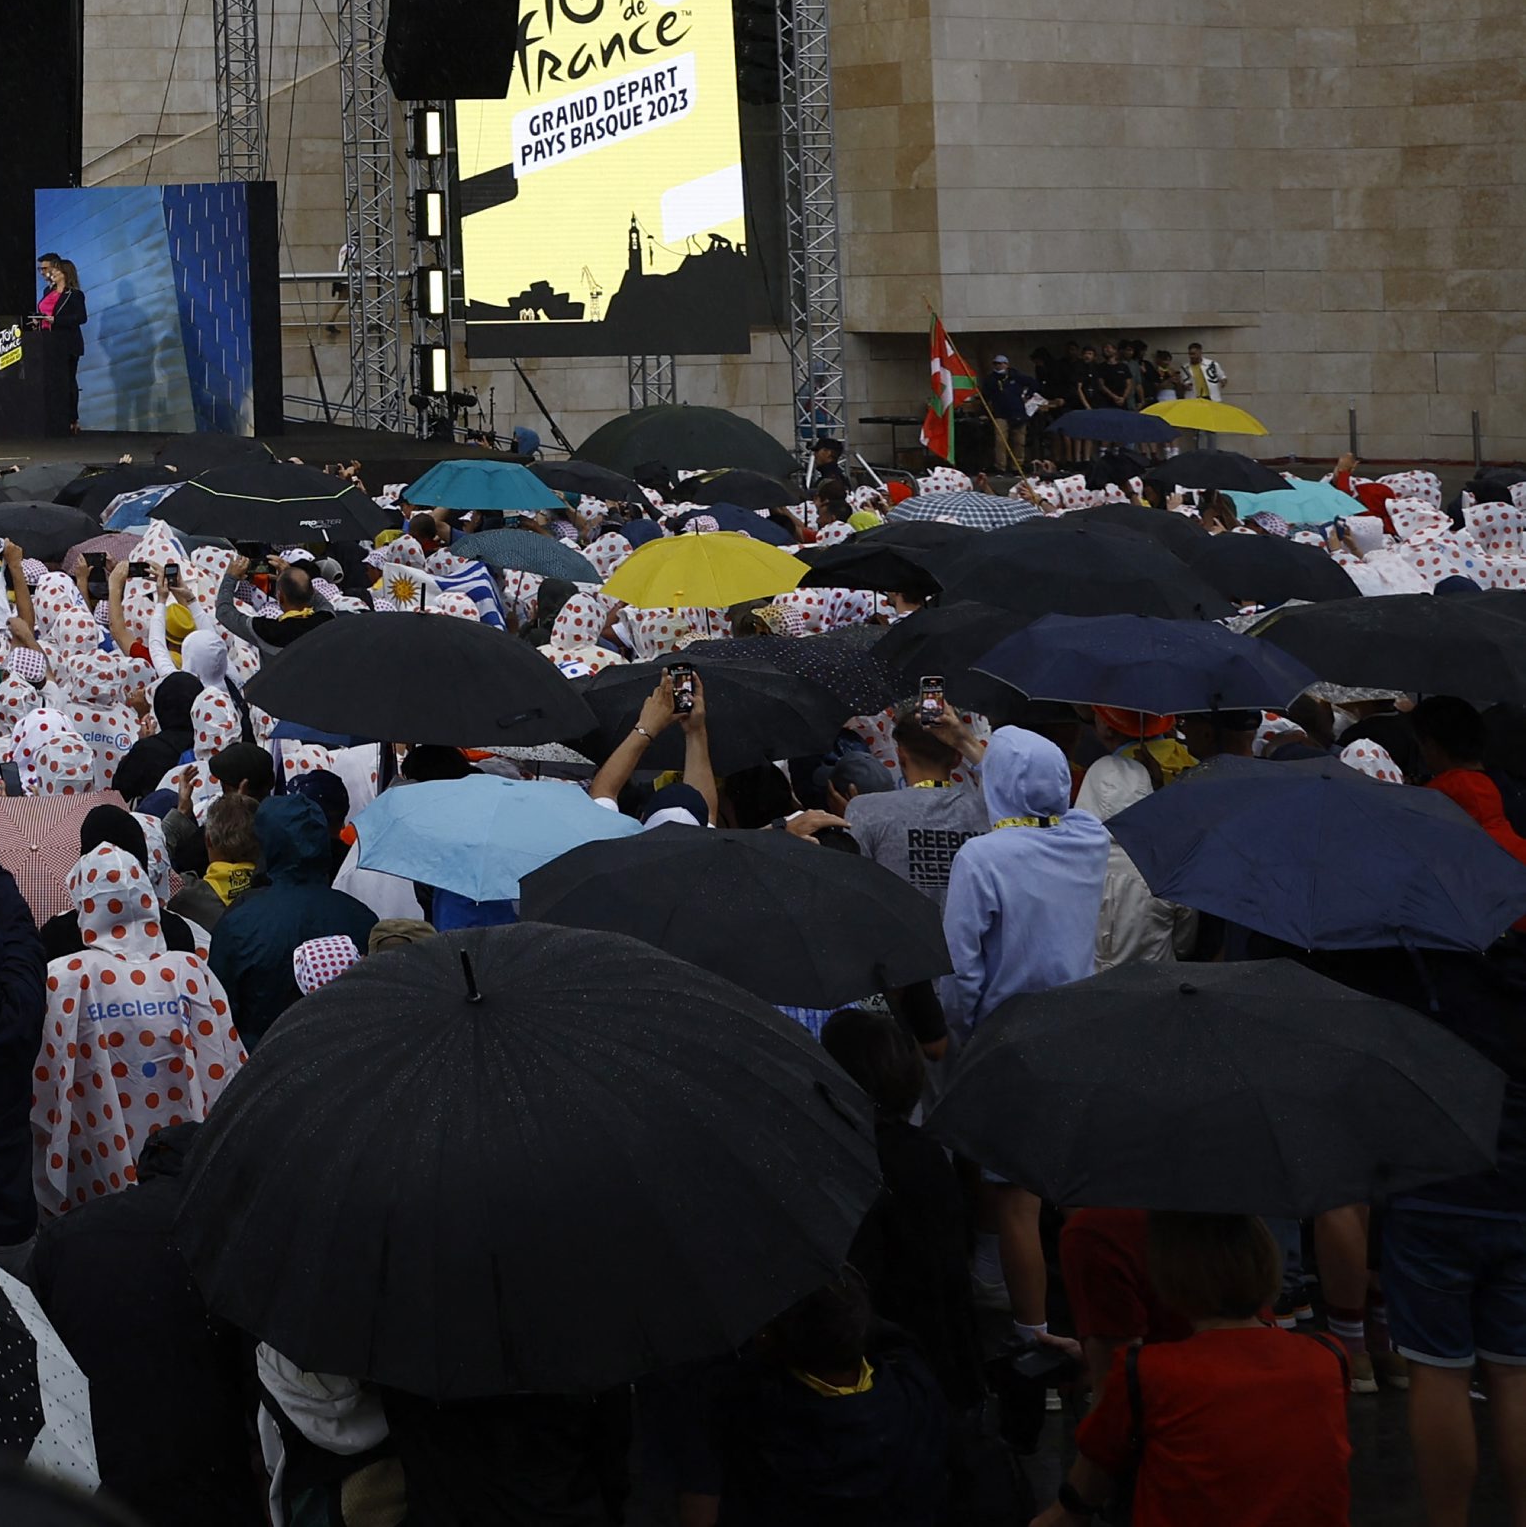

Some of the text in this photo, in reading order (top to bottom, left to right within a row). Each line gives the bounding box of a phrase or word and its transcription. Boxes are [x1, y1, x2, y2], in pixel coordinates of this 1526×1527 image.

[520, 86, 689, 167] PAYS BASQUE 2023
[529, 66, 679, 137] GRAND DÉPART
